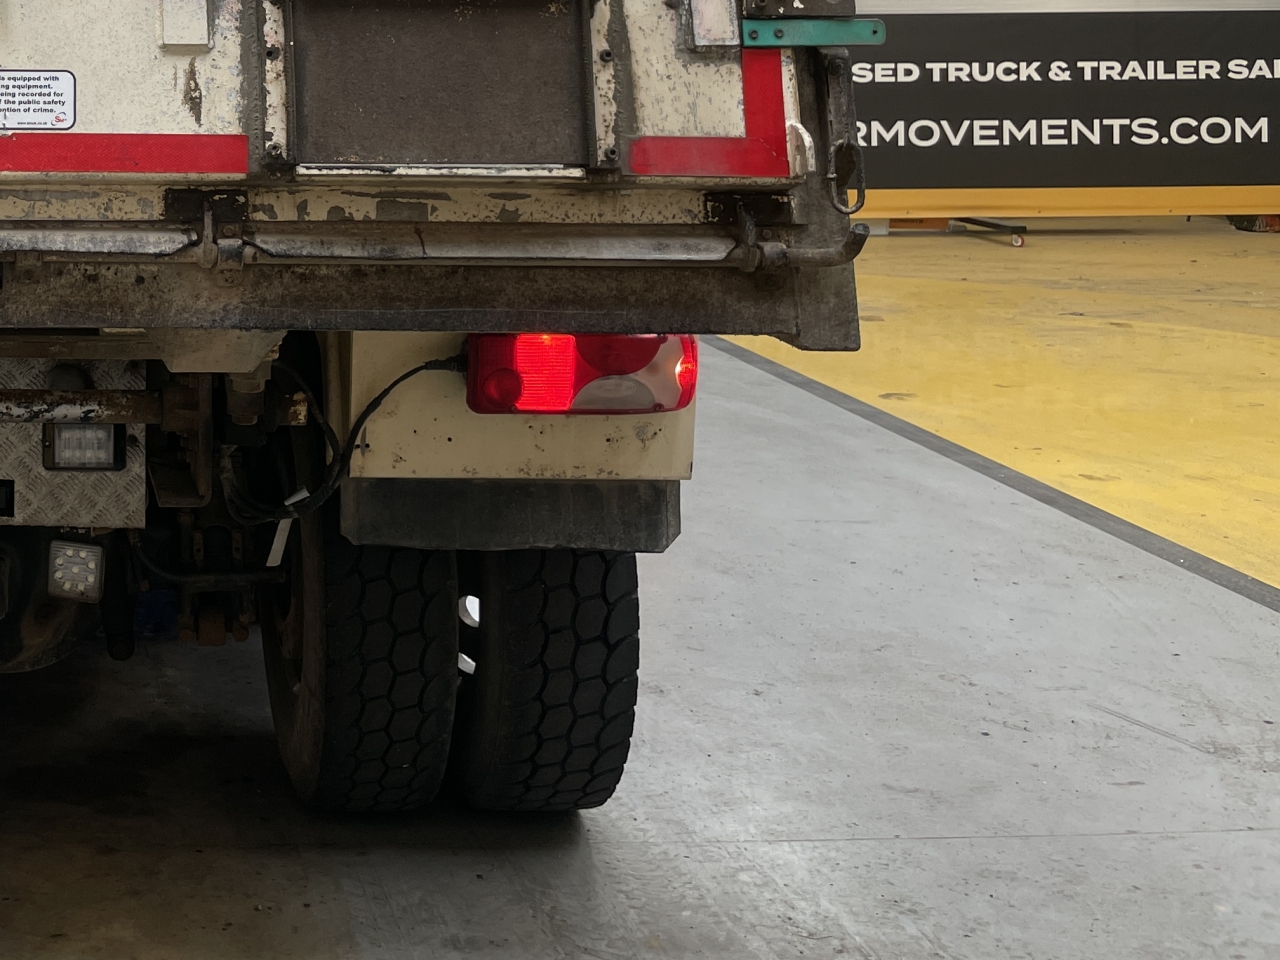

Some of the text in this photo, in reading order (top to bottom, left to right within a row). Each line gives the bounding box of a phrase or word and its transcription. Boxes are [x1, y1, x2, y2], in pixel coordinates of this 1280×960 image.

[925, 61, 1043, 83] TRUCK
[1047, 61, 1072, 82] &
[1077, 60, 1221, 81] TRAILER
